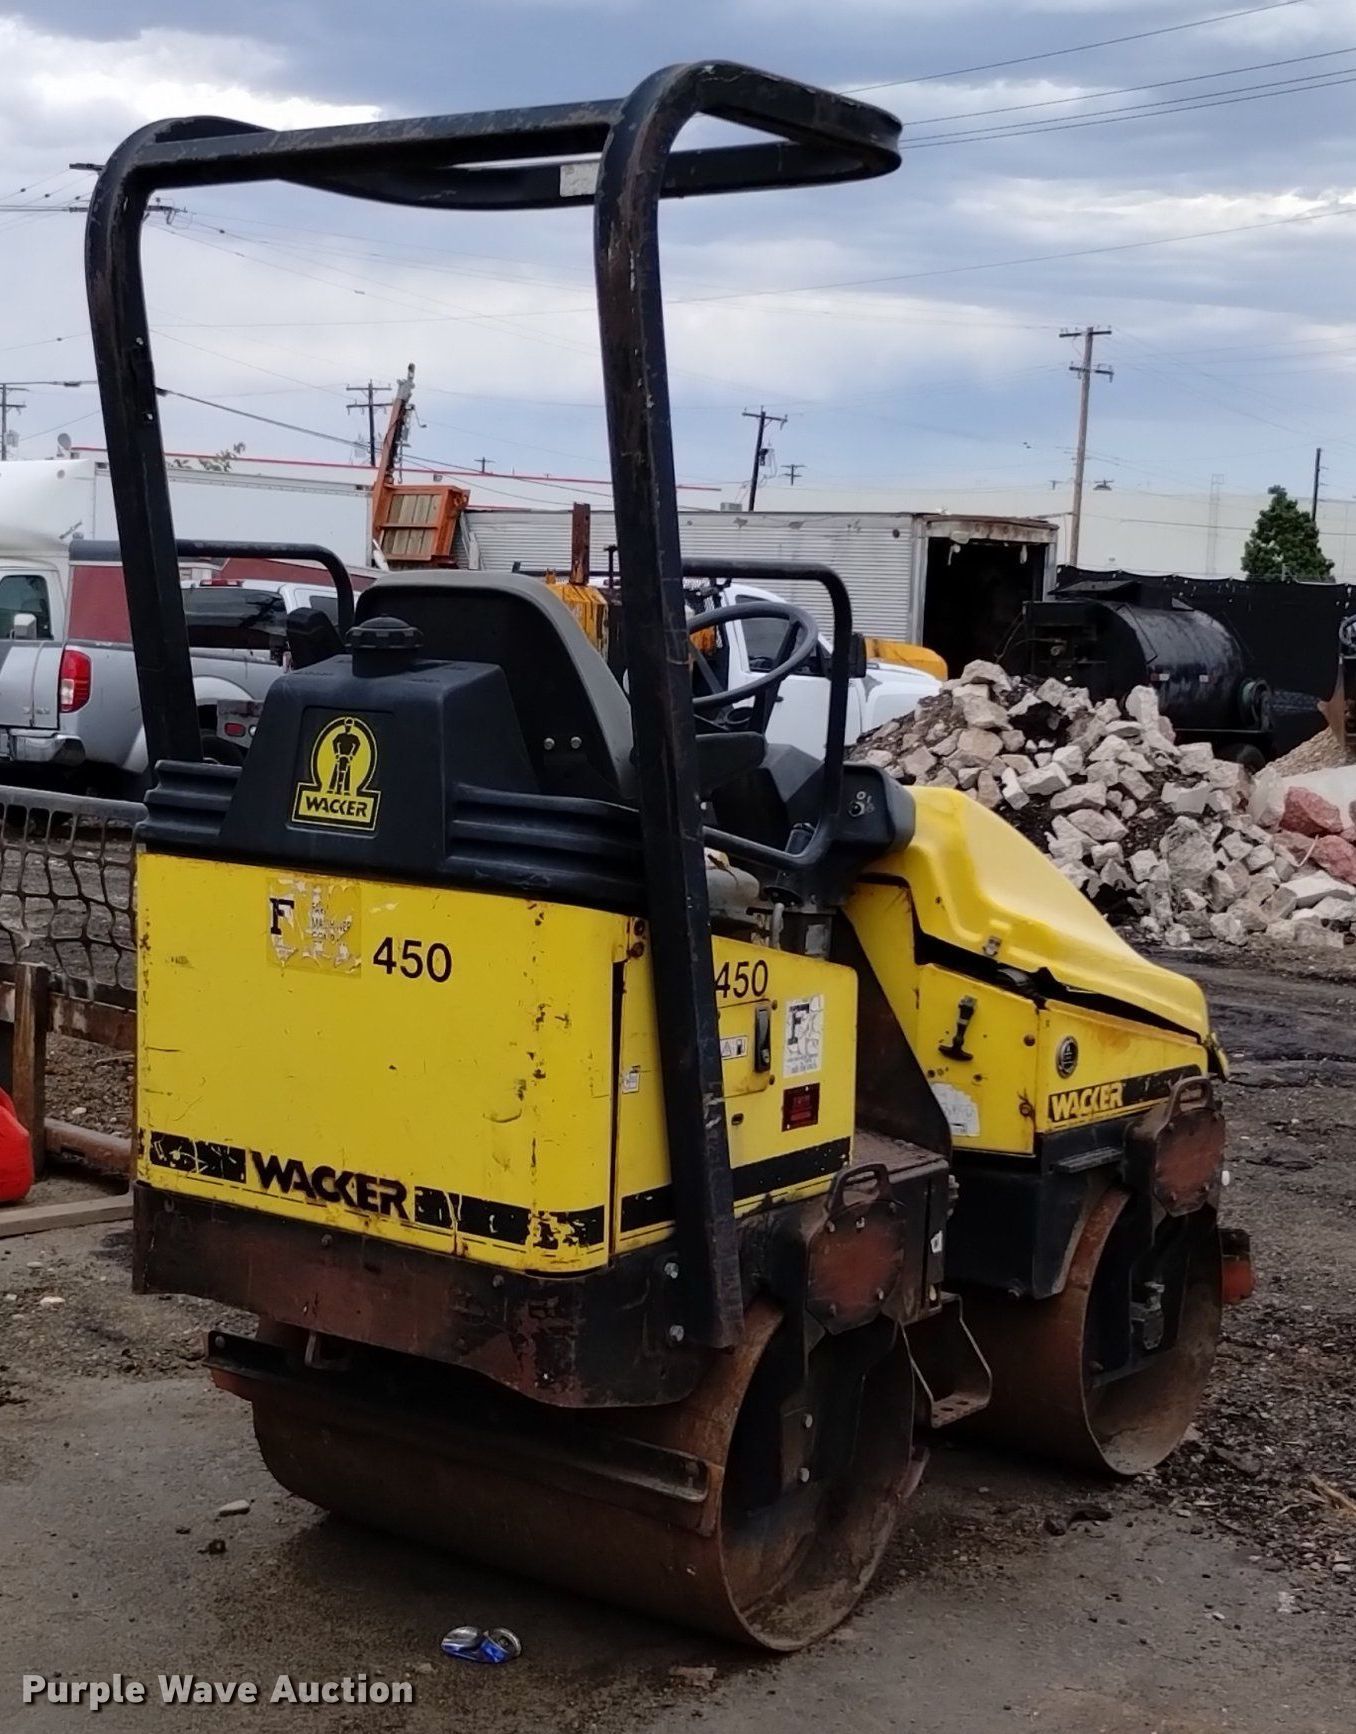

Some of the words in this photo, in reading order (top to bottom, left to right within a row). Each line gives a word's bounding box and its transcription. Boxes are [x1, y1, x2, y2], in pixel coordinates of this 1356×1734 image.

[304, 795, 369, 818] WACKER
[372, 936, 453, 983] 450
[715, 959, 769, 999] 450
[1051, 1082, 1124, 1122] WACKER
[250, 1150, 414, 1221] WACKER
